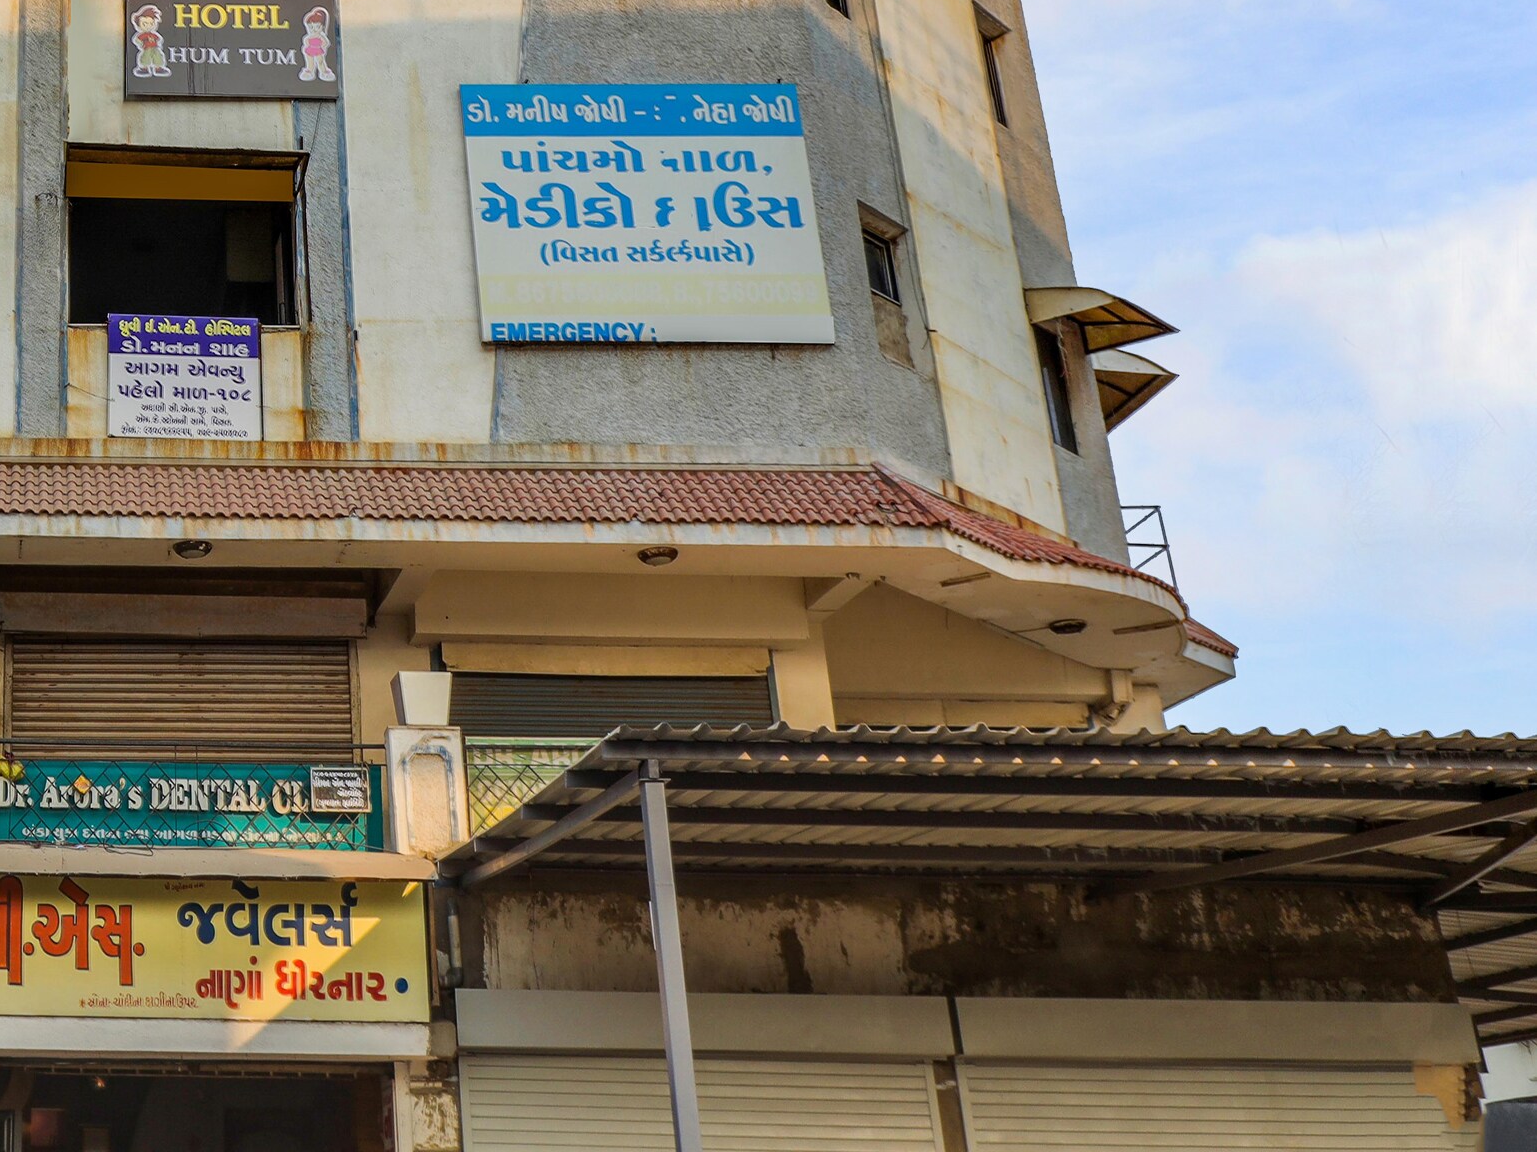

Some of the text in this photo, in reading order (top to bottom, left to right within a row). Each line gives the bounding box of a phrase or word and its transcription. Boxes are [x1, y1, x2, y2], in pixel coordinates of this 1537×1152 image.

[174, 3, 290, 30] HOTEL
[168, 46, 297, 66] HUM TUM
[506, 95, 569, 123] મનીષ
[574, 95, 626, 123] જોષી
[692, 95, 736, 125] નેહા
[742, 95, 795, 123] જોષી
[501, 141, 644, 173] પાંચમો
[479, 182, 635, 229] મેડીકો
[209, 342, 250, 357] શાહ
[125, 359, 245, 384] આગમ એવન્યુ
[118, 380, 164, 398] પહેલો
[149, 777, 267, 813] DENTAL
